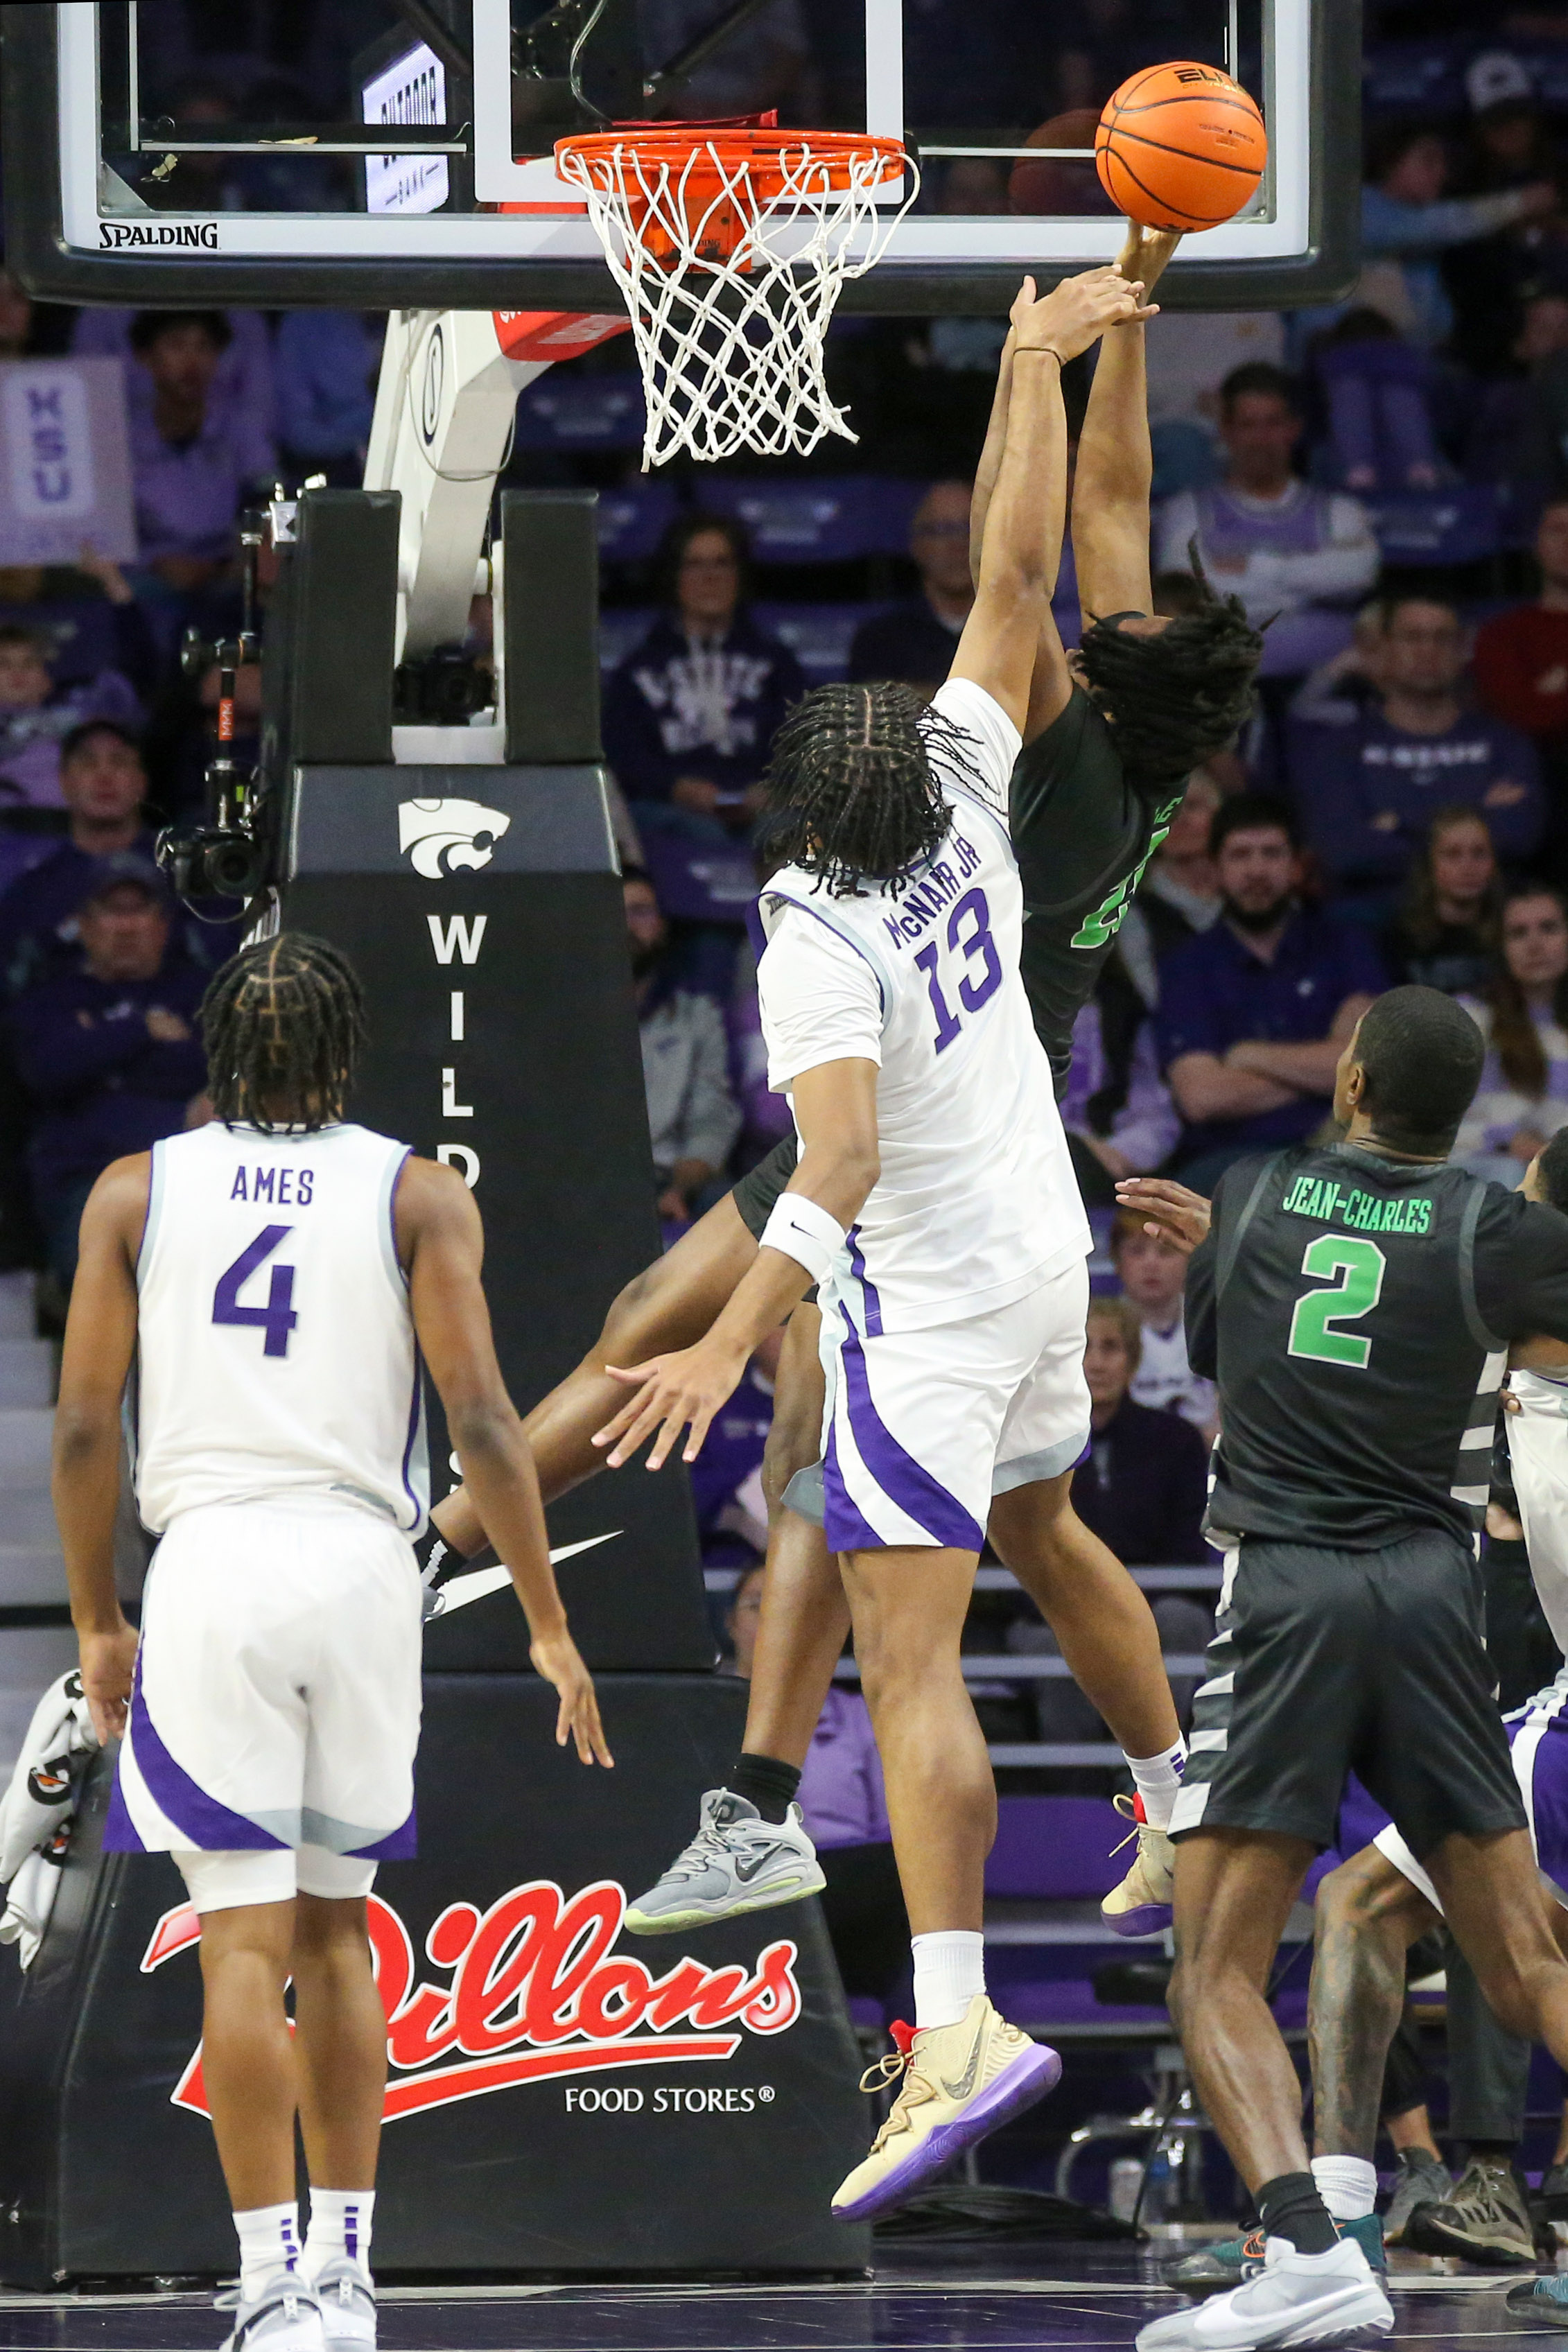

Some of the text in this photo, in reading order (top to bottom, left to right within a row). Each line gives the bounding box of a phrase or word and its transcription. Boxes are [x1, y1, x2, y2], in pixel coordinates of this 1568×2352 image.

[99, 223, 218, 249] SPALDING
[952, 836, 982, 879] JR
[914, 887, 1002, 1056] 13
[229, 1165, 314, 1206] AMES
[1282, 1176, 1433, 1234] JEAN-CHARLES
[211, 1223, 298, 1358] 4
[1287, 1232, 1387, 1370] 2
[565, 2087, 645, 2112] FOOD
